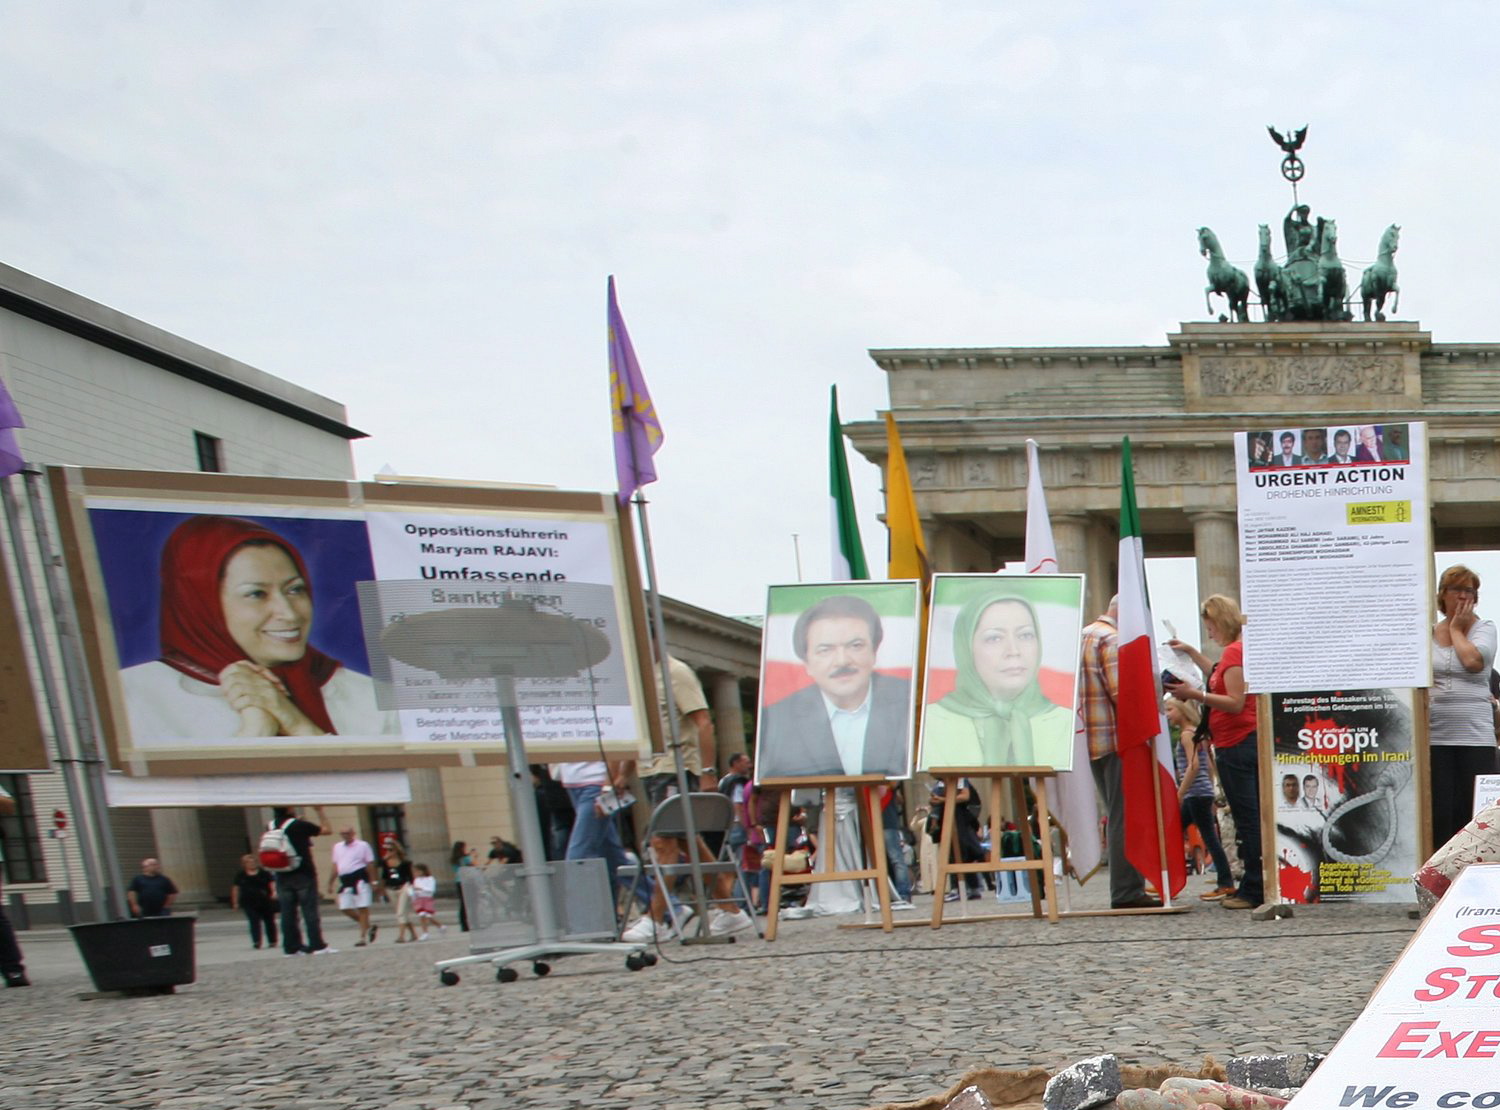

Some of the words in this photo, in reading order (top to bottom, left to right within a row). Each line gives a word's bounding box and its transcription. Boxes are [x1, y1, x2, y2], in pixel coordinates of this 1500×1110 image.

[1254, 471, 1329, 488] URGENT
[1335, 467, 1405, 484] ACTION
[1266, 487, 1321, 500] DROHENDE
[1324, 485, 1393, 498] HINRICHTUNG
[1351, 504, 1386, 516] AMNESTY
[404, 522, 569, 541] Oppositionsführerin
[420, 542, 489, 558] Maryam
[493, 545, 560, 558] RAJAVI:
[420, 565, 567, 583] Umfassende
[1282, 697, 1316, 706] Jahrestag
[1316, 696, 1329, 704] des
[1330, 695, 1367, 704] Massakers
[1293, 704, 1331, 714] politischen
[1331, 702, 1374, 712] Gefangenen
[1384, 702, 1399, 710] Iran
[1297, 726, 1379, 754] Stoppt
[1276, 752, 1360, 766] Hinrichtungen
[1362, 750, 1379, 763] im
[1381, 751, 1411, 763] Iran!
[1337, 884, 1354, 893] Tode
[1338, 1085, 1420, 1109] We
